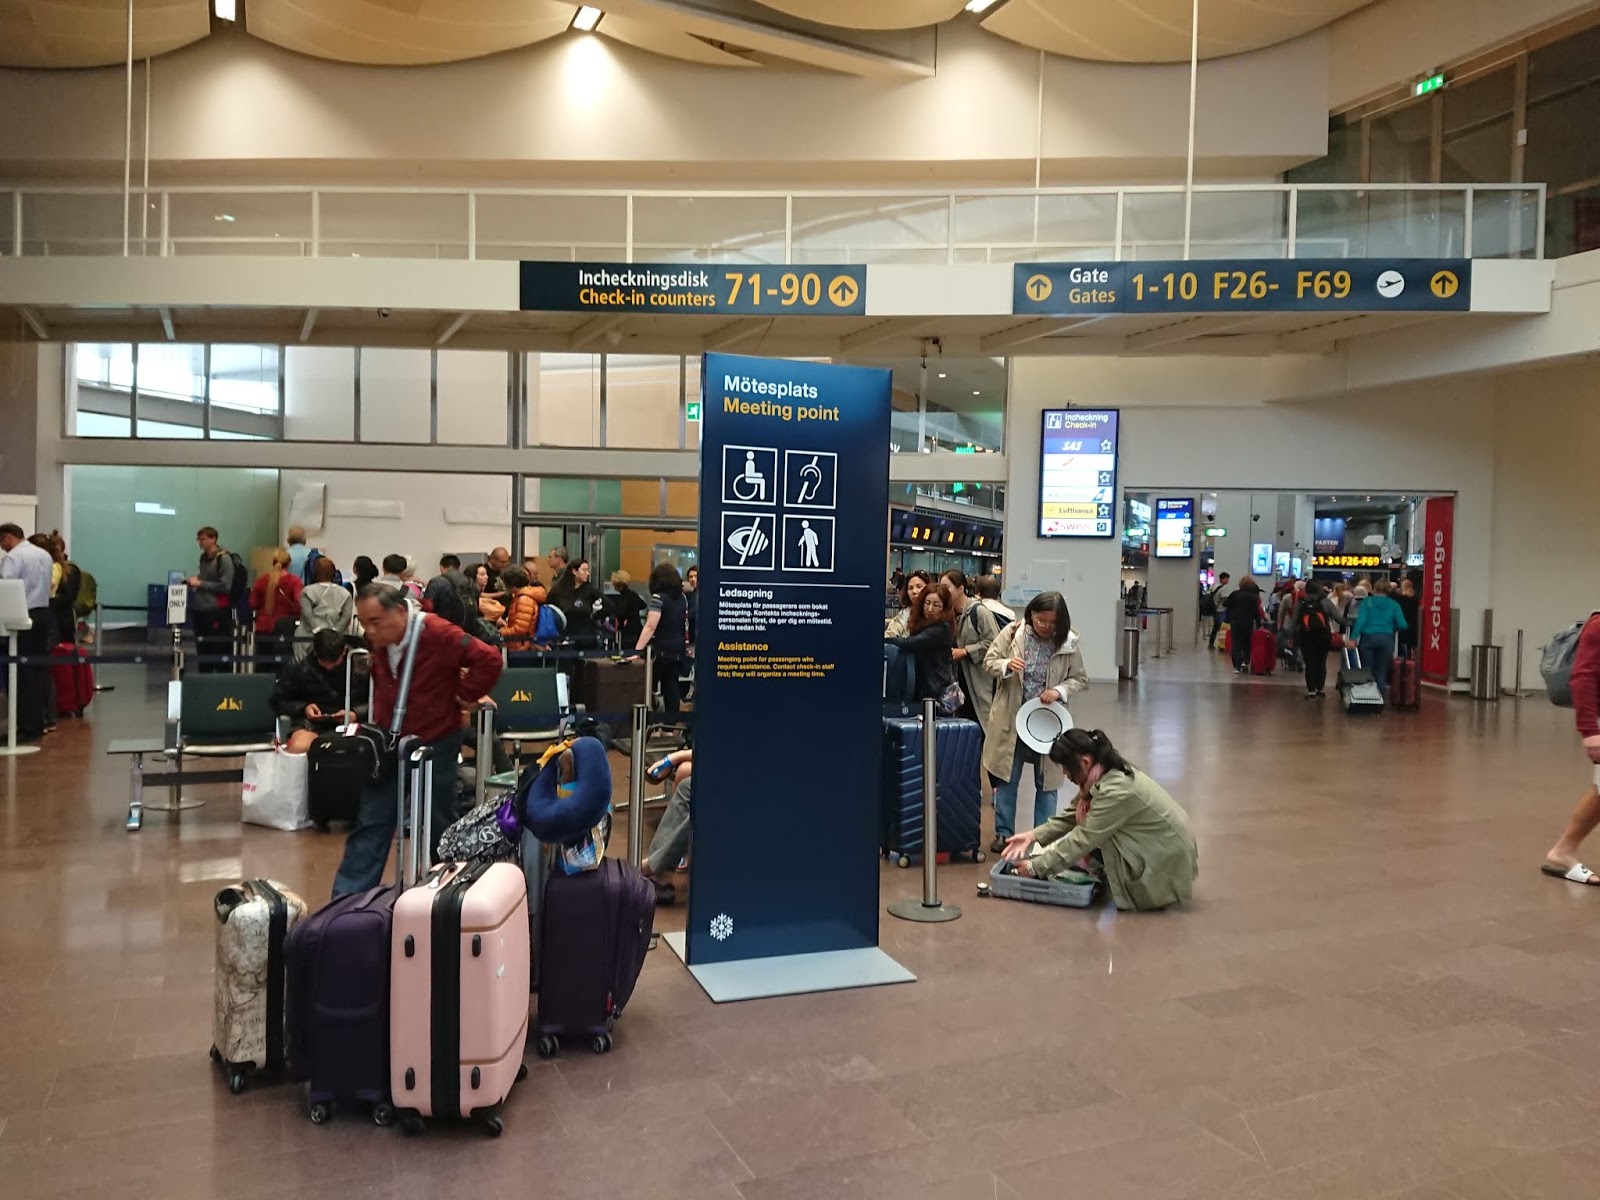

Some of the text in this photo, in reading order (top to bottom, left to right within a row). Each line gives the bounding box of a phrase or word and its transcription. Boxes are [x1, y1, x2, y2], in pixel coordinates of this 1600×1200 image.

[578, 270, 709, 291] Incheckningsdisk
[1069, 267, 1109, 285] Gate
[724, 272, 822, 307] 71-90
[1131, 270, 1351, 301] 1-10 F26- F69
[579, 288, 716, 307] Check-in counters
[1068, 287, 1116, 305] Gates
[724, 375, 819, 399] Mötesplats
[723, 397, 840, 422] Meeting point
[1064, 413, 1109, 423] Incheckning
[1064, 421, 1097, 429] Check-in
[1319, 556, 1341, 566] 1-24
[1341, 556, 1380, 566] F26-F69
[719, 587, 773, 600] Ledsagning
[1430, 530, 1446, 651] x-change
[169, 600, 185, 608] ONLY
[718, 609, 753, 617] ledsagning.
[719, 601, 752, 609] Mötesplats
[718, 641, 769, 651] Assistance
